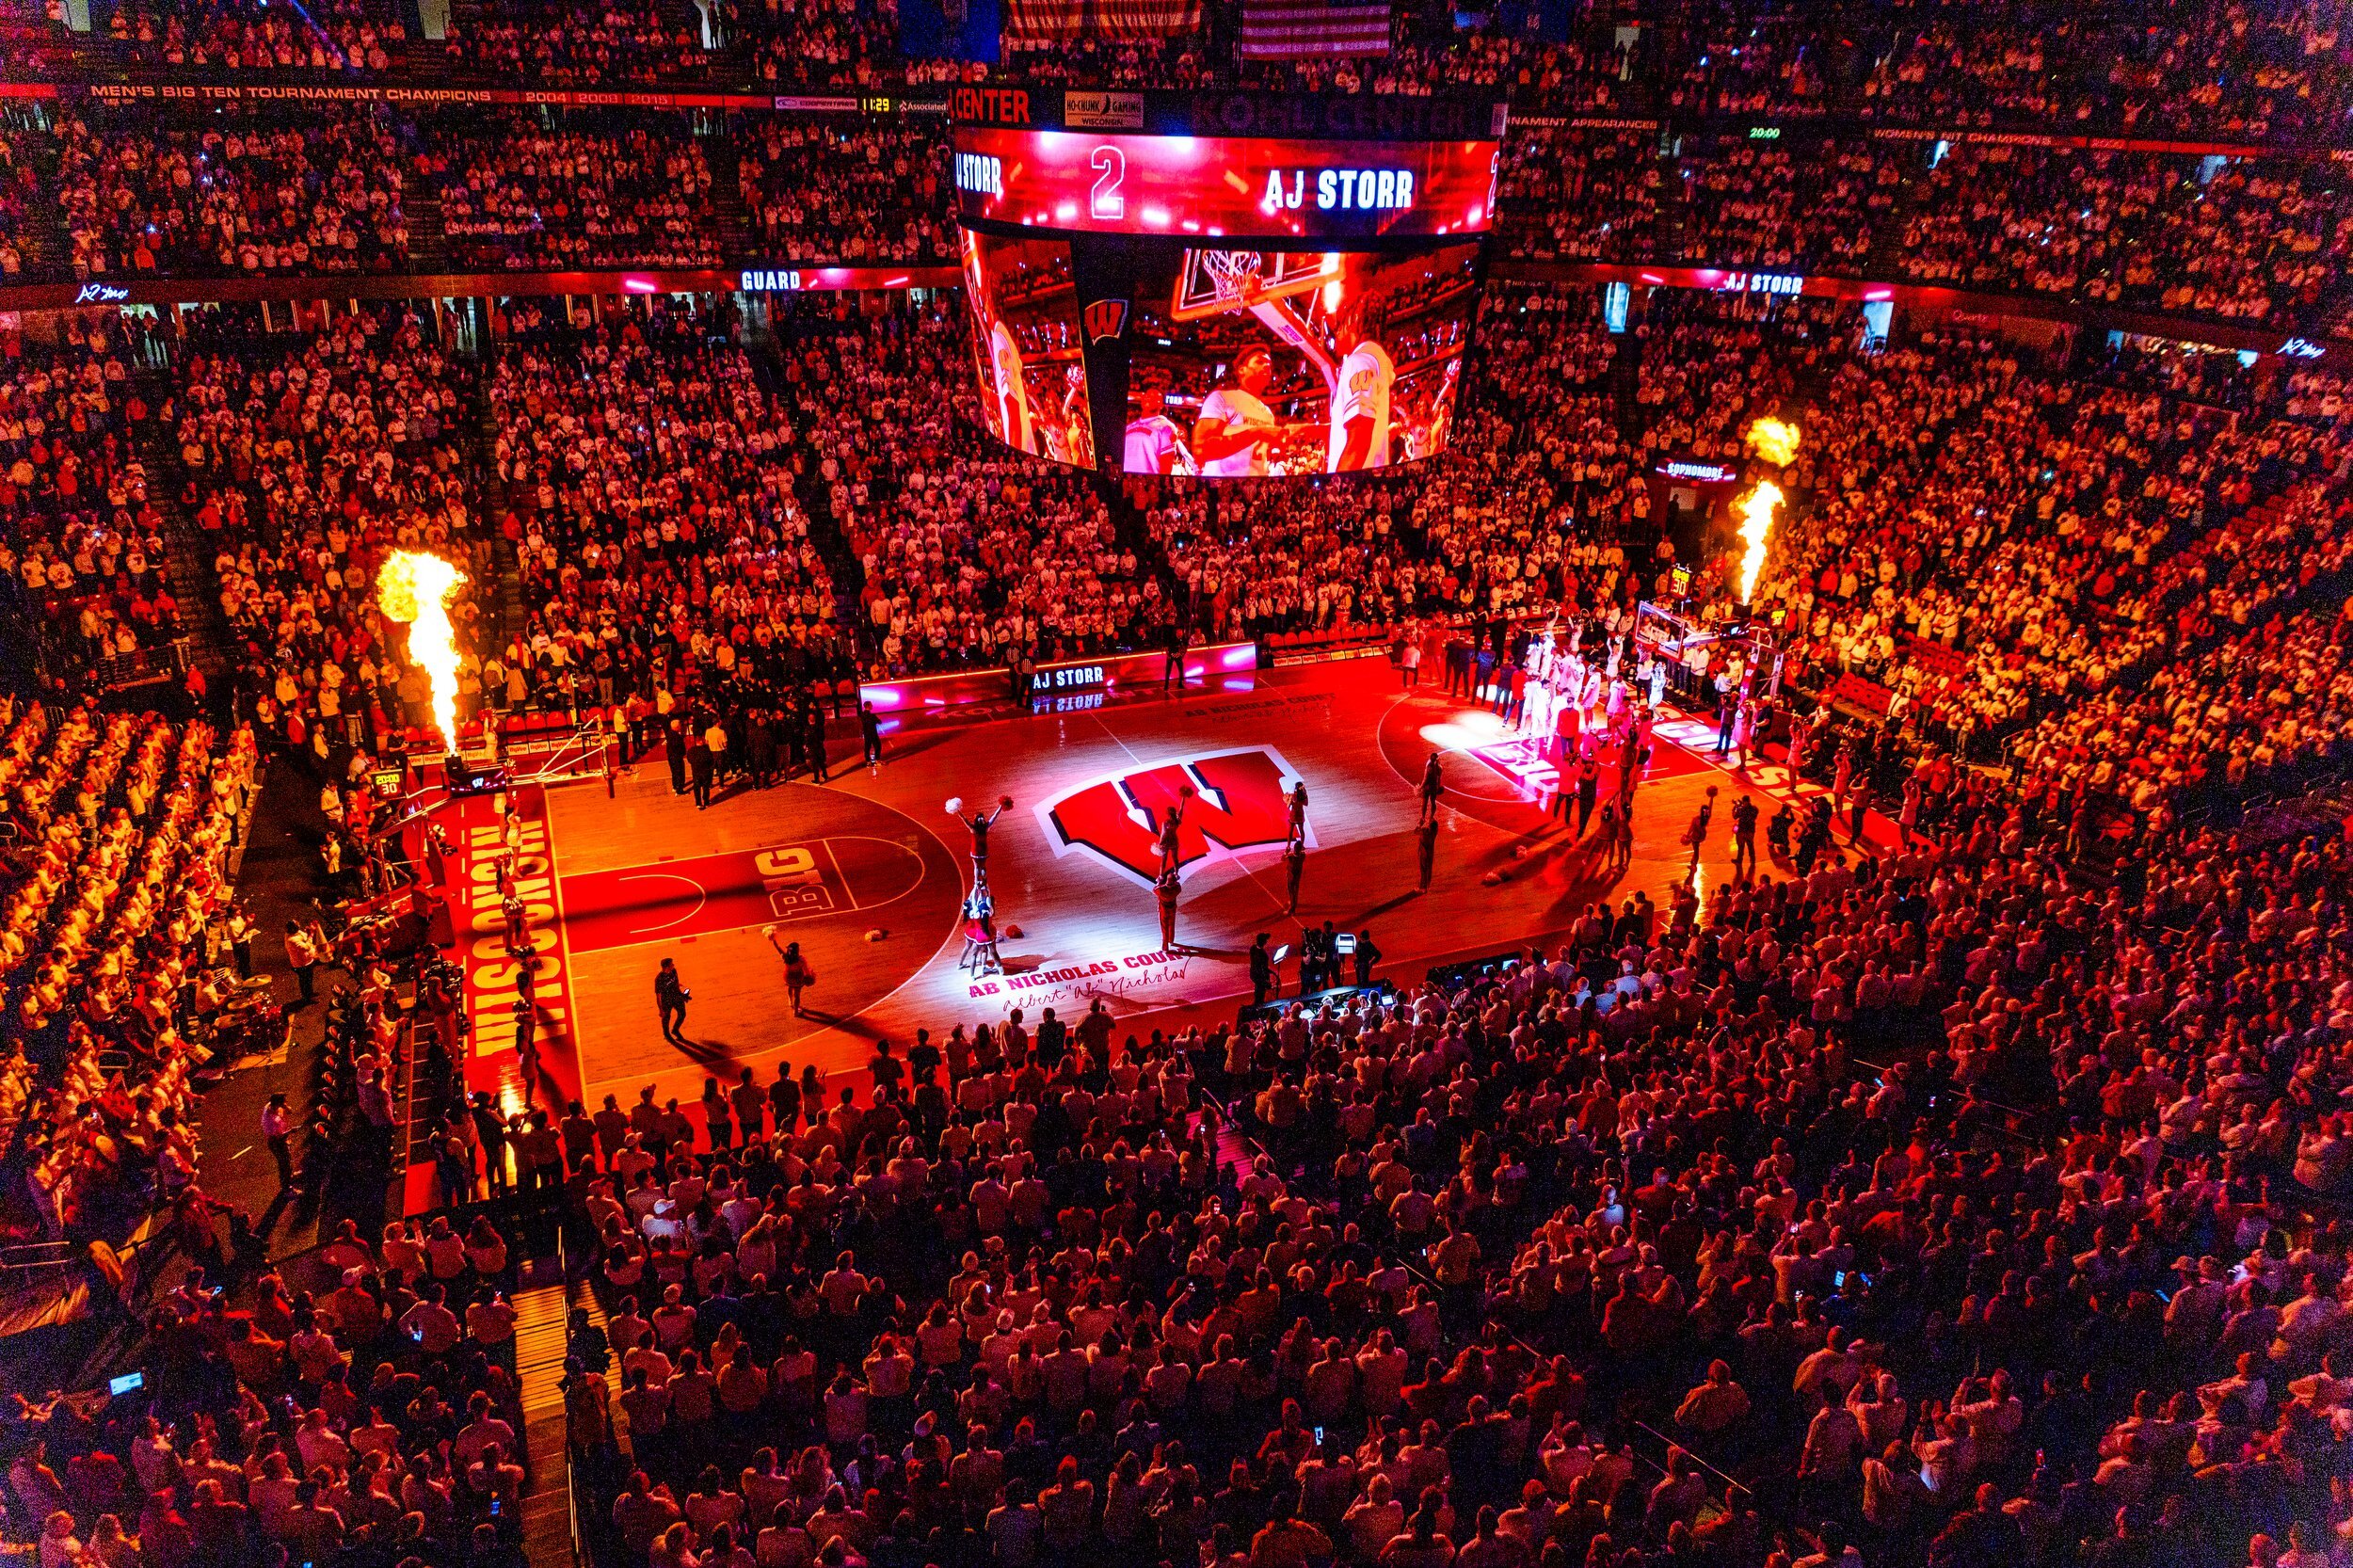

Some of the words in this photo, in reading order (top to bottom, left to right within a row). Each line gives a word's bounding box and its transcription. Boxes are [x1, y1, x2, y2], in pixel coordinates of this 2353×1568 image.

[91, 86, 155, 97] MEN'S
[162, 87, 196, 97] BIG
[201, 88, 241, 98] TEN
[247, 88, 379, 100] TOURNAMENT
[386, 89, 491, 101] CHAMPIONS
[526, 92, 567, 103] 2004
[863, 98, 889, 112] 11:29
[907, 102, 947, 112] Associated
[955, 88, 1031, 123] CENTER
[1066, 100, 1099, 111] HO-CHUNK
[1112, 102, 1142, 113] GAMING
[1082, 118, 1123, 126] WISCONSIN
[1571, 119, 1657, 130] APPEARANCES
[1749, 128, 1781, 139] 20:00
[1874, 129, 1936, 140] WOMEN'S
[1967, 134, 2053, 146] CHAMPIONS
[963, 153, 1002, 194] STORR
[1091, 145, 1125, 219] 2
[1265, 169, 1305, 210] AJ
[1318, 169, 1414, 209] STORR
[741, 271, 800, 291] GUARD
[1726, 272, 1746, 292] AJ
[1750, 274, 1803, 294] STORR
[1667, 462, 1724, 479] SOPHOMORE
[1671, 578, 1686, 596] 30
[1032, 672, 1050, 690] AJ
[1056, 666, 1103, 687] STORR
[376, 774, 400, 785] 20:00
[380, 785, 398, 795] 30
[754, 847, 834, 918] BIG
[471, 820, 568, 1058] WISCONSIN
[968, 982, 1000, 999] AB
[1005, 960, 1119, 991] NICHOLAS
